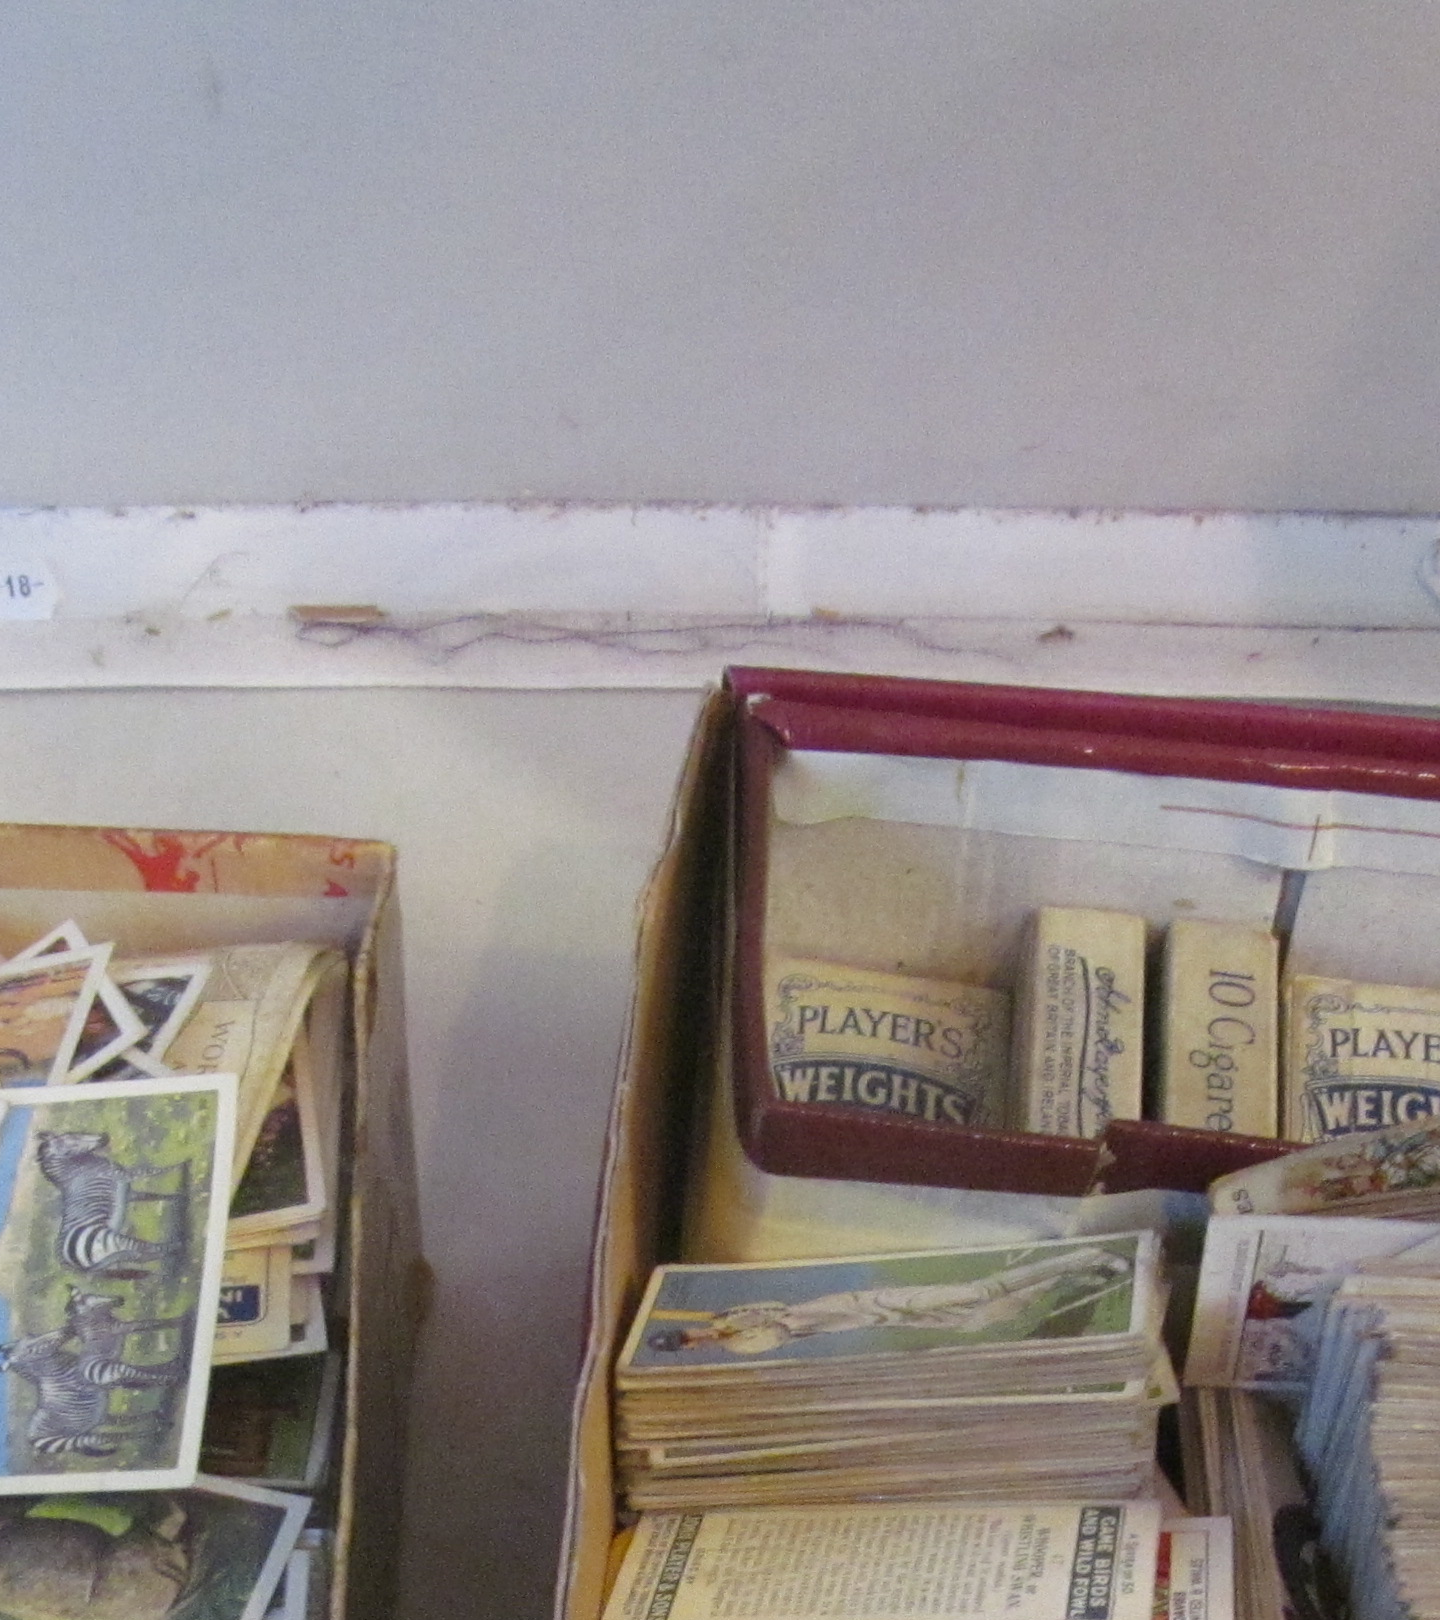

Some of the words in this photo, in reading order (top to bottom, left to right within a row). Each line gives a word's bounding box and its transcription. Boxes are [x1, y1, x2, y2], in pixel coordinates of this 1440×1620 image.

[6, 574, 32, 599] 18
[1208, 967, 1257, 1008] 10
[797, 1003, 966, 1060] PLAYER'S
[1081, 1509, 1098, 1535] AND
[1096, 1516, 1115, 1552] GAME
[662, 1540, 689, 1583] PLAYER
[1076, 1539, 1094, 1574] WILD
[1070, 1577, 1088, 1616] FOWL
[1089, 1558, 1110, 1607] BIRDS
